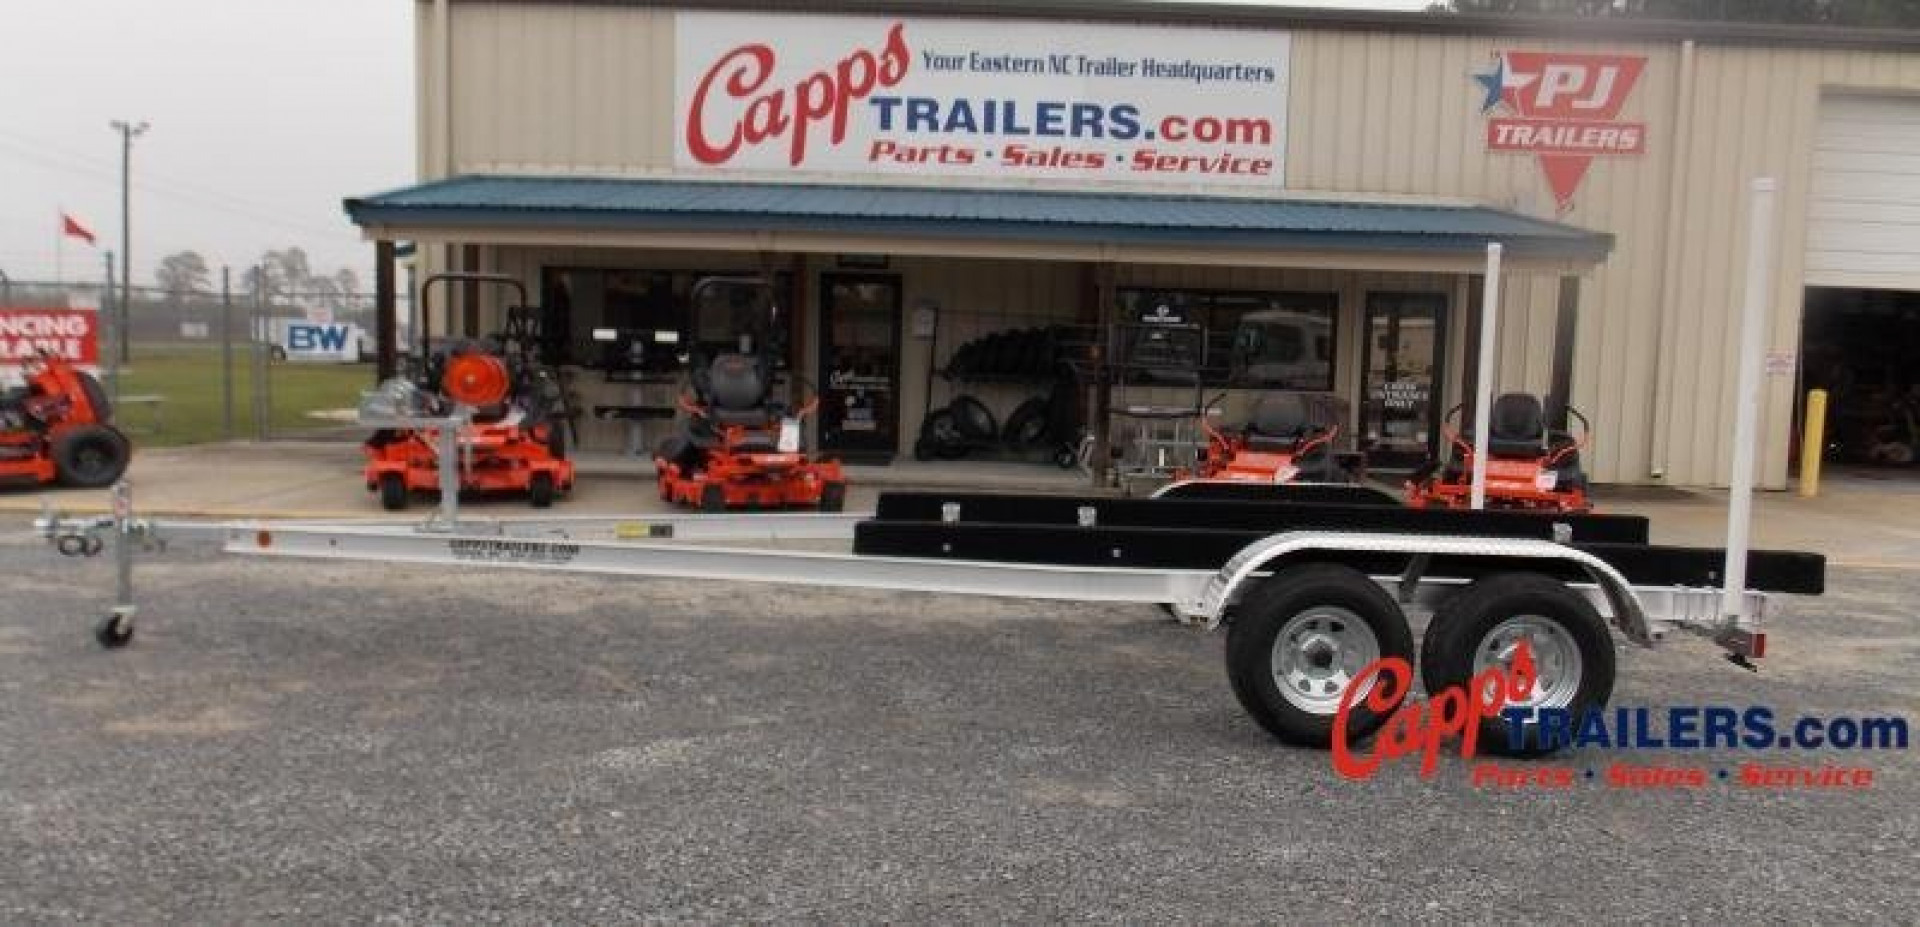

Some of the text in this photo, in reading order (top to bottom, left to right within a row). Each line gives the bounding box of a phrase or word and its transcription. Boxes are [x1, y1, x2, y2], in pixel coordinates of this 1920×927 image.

[922, 51, 1275, 84] Your Eastern NC Trailer Headquarters
[1535, 64, 1620, 109] PJ
[687, 21, 910, 167] Capps
[869, 97, 1271, 145] TRAILERS.com
[1496, 124, 1640, 149] TRAILERS
[869, 141, 1274, 176] Parts Sales Service
